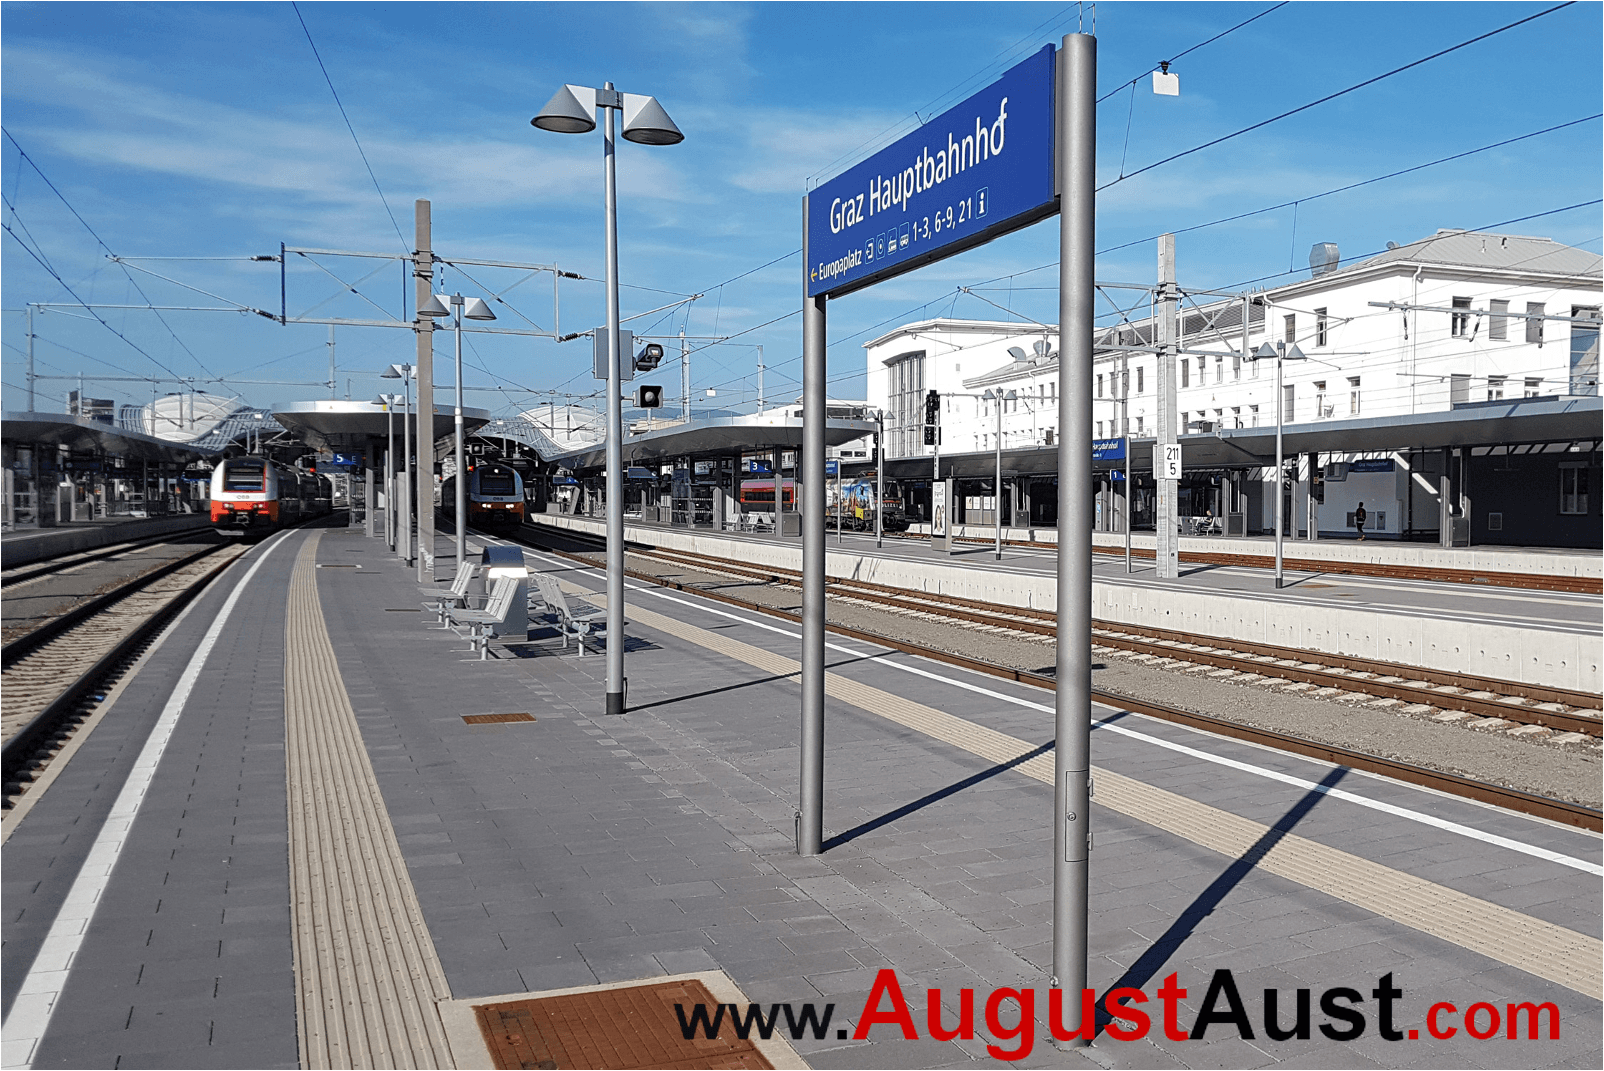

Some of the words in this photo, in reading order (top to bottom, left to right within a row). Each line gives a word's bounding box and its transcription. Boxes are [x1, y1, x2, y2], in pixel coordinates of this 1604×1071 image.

[830, 193, 864, 234] Graz
[869, 97, 1008, 215] Hauptbahnhof
[819, 248, 862, 280] Europaplatz
[912, 217, 931, 241] 1-3,
[934, 210, 955, 233] 6-9,
[958, 197, 972, 222] 21
[336, 453, 344, 463] 5
[351, 455, 357, 463] E
[1166, 447, 1178, 460] 211
[752, 461, 758, 471] 3
[1169, 462, 1176, 475] 5
[1113, 471, 1117, 479] 1
